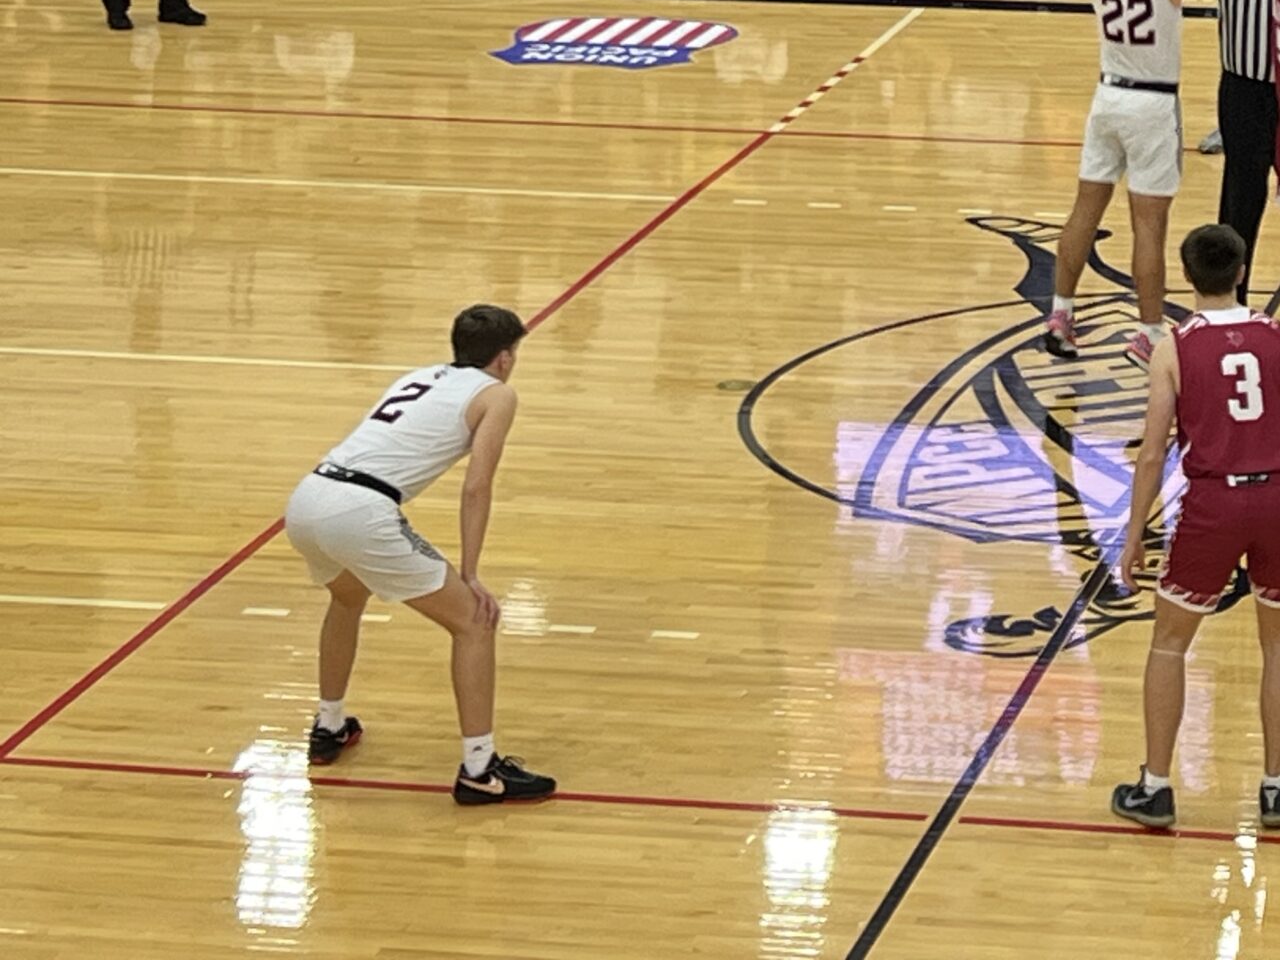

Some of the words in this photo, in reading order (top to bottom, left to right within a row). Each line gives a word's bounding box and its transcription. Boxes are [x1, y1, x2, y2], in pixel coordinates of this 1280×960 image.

[521, 51, 659, 65] UNION
[523, 42, 679, 58] PACIFIC
[1221, 352, 1265, 422] 3
[369, 381, 433, 425] 2
